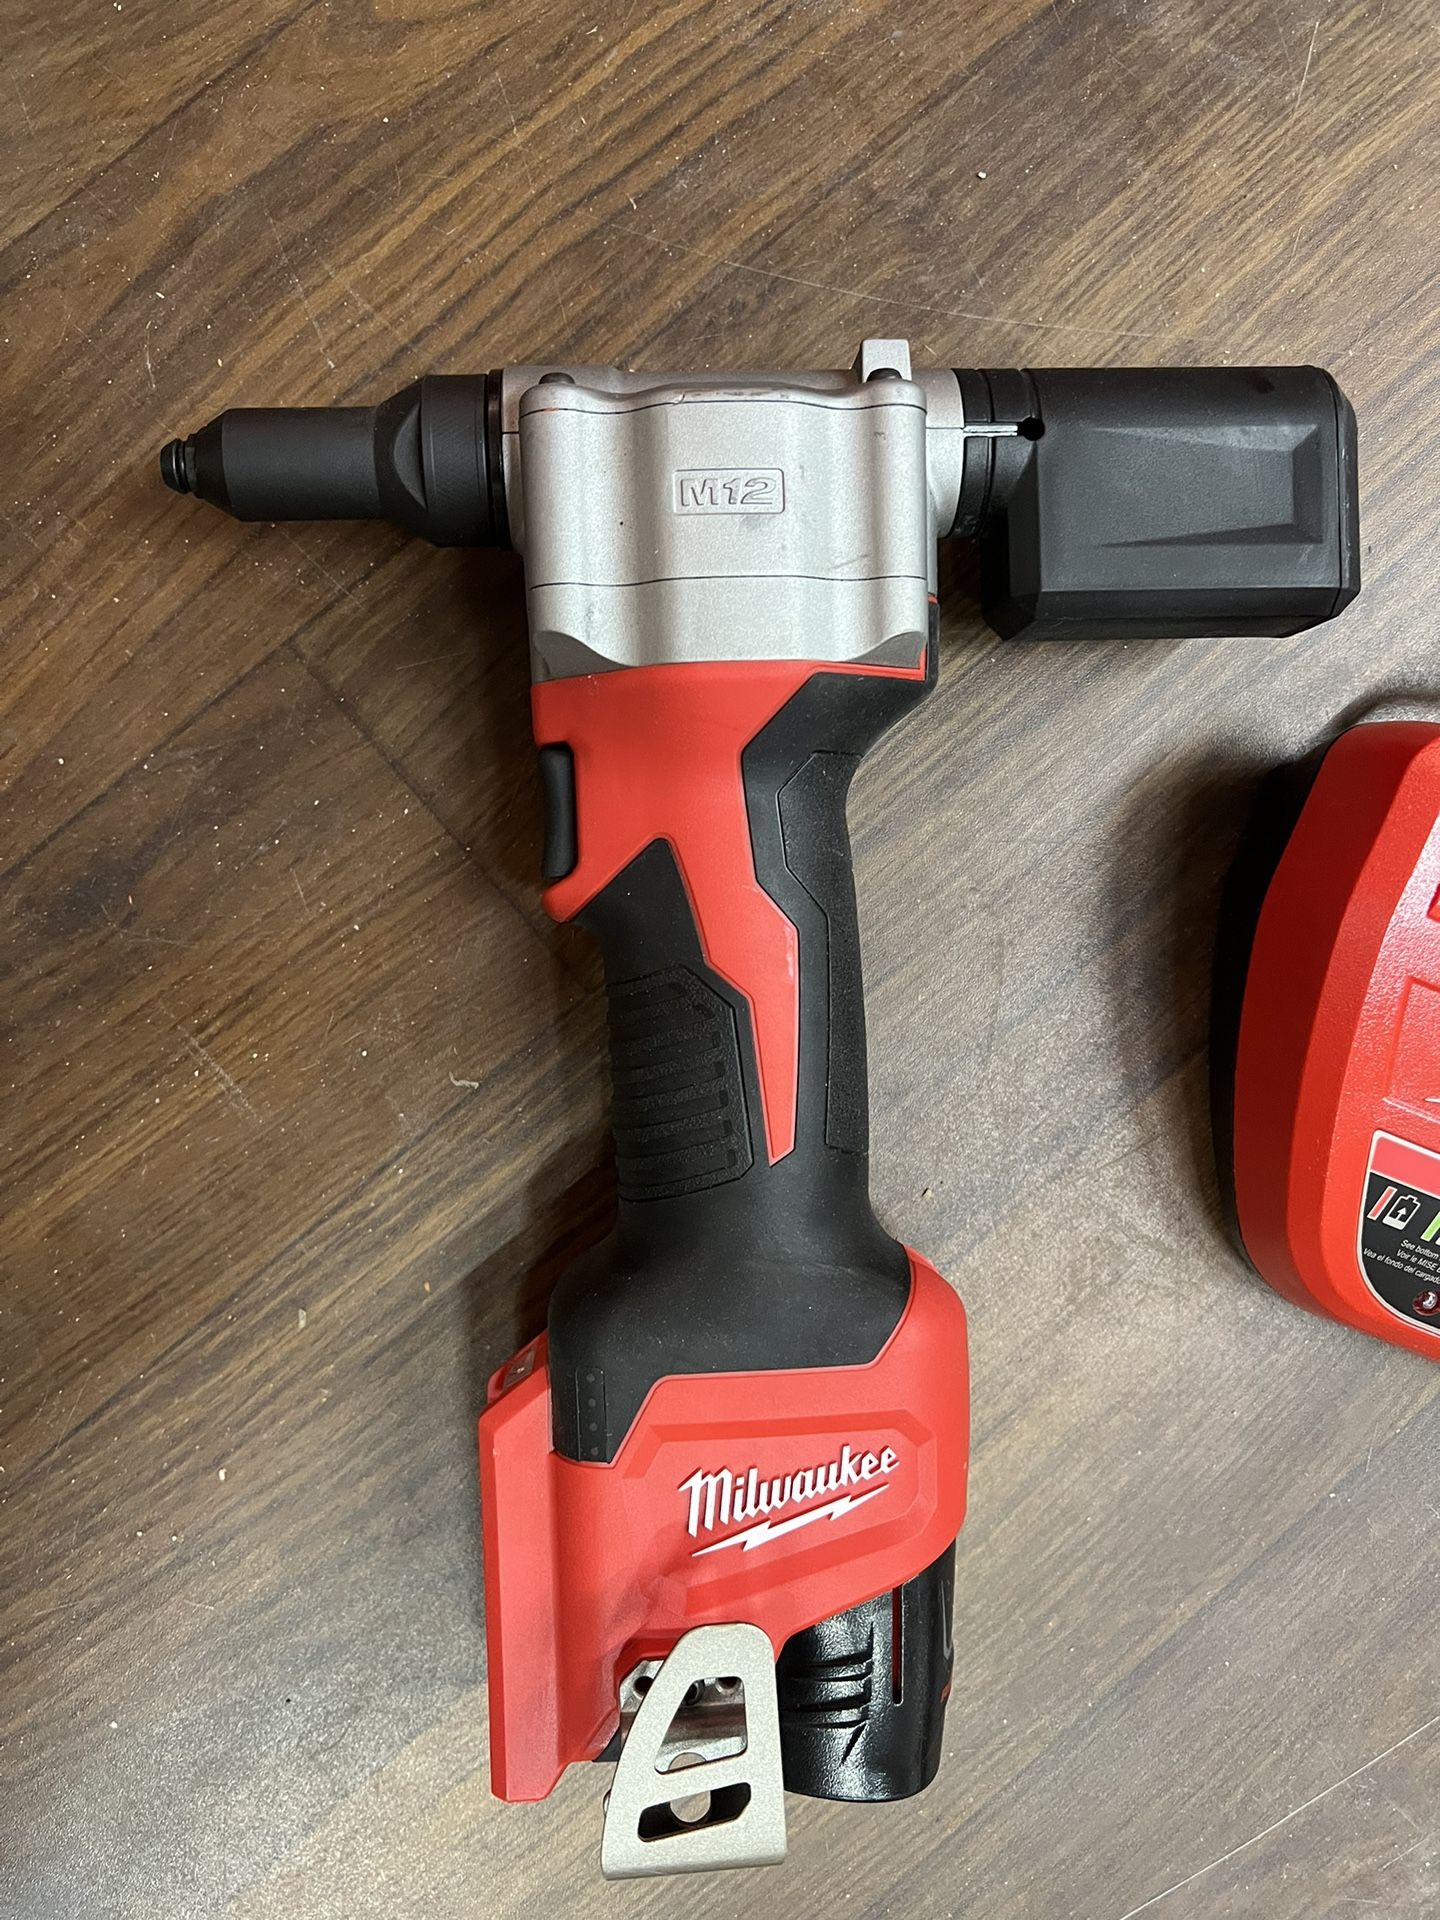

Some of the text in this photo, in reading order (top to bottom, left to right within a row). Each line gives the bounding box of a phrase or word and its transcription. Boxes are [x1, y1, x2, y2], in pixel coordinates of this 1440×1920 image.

[680, 477, 777, 507] M12
[1363, 1248, 1377, 1259] Vea
[1384, 1256, 1404, 1269] fondo
[1403, 1265, 1417, 1274] del
[1401, 1239, 1439, 1260] See bottom
[1410, 1255, 1418, 1263] le
[1417, 1258, 1438, 1271] MISE
[677, 1443, 900, 1538] Milwaukee
